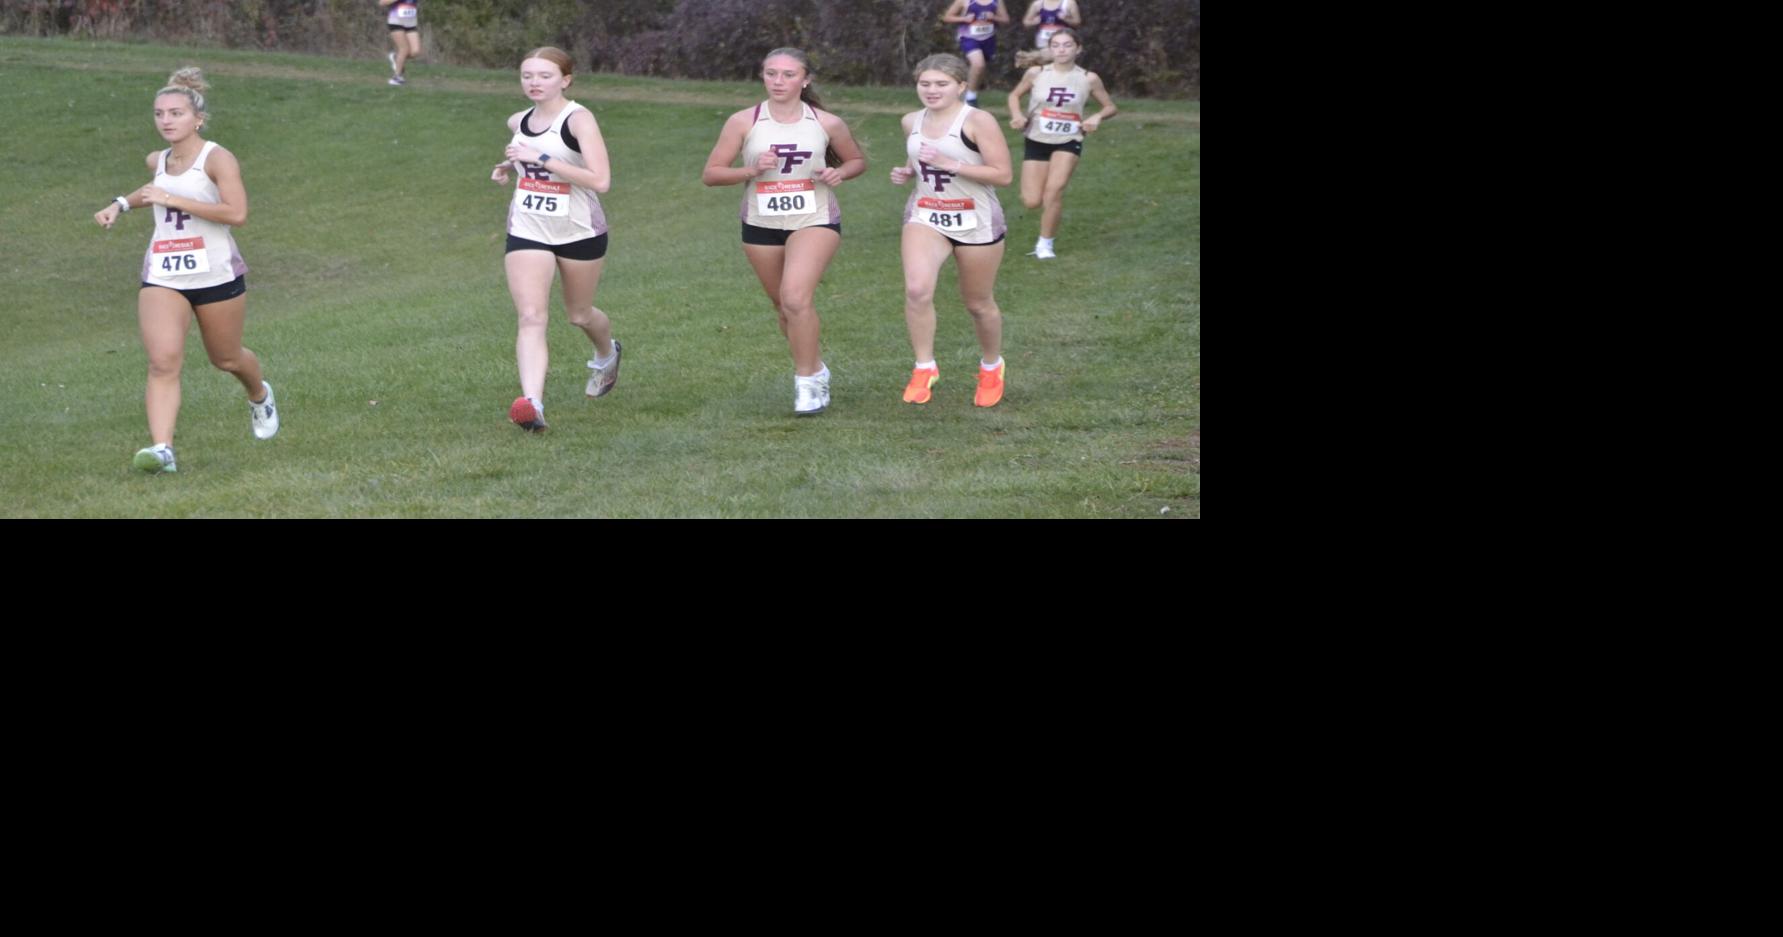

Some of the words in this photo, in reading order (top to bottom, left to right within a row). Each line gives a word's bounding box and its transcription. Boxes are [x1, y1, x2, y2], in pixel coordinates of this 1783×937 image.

[1046, 87, 1075, 107] FF
[1045, 121, 1072, 133] 478
[522, 194, 558, 212] 475
[767, 194, 806, 212] 480
[929, 212, 963, 228] 481
[162, 254, 197, 271] 476
